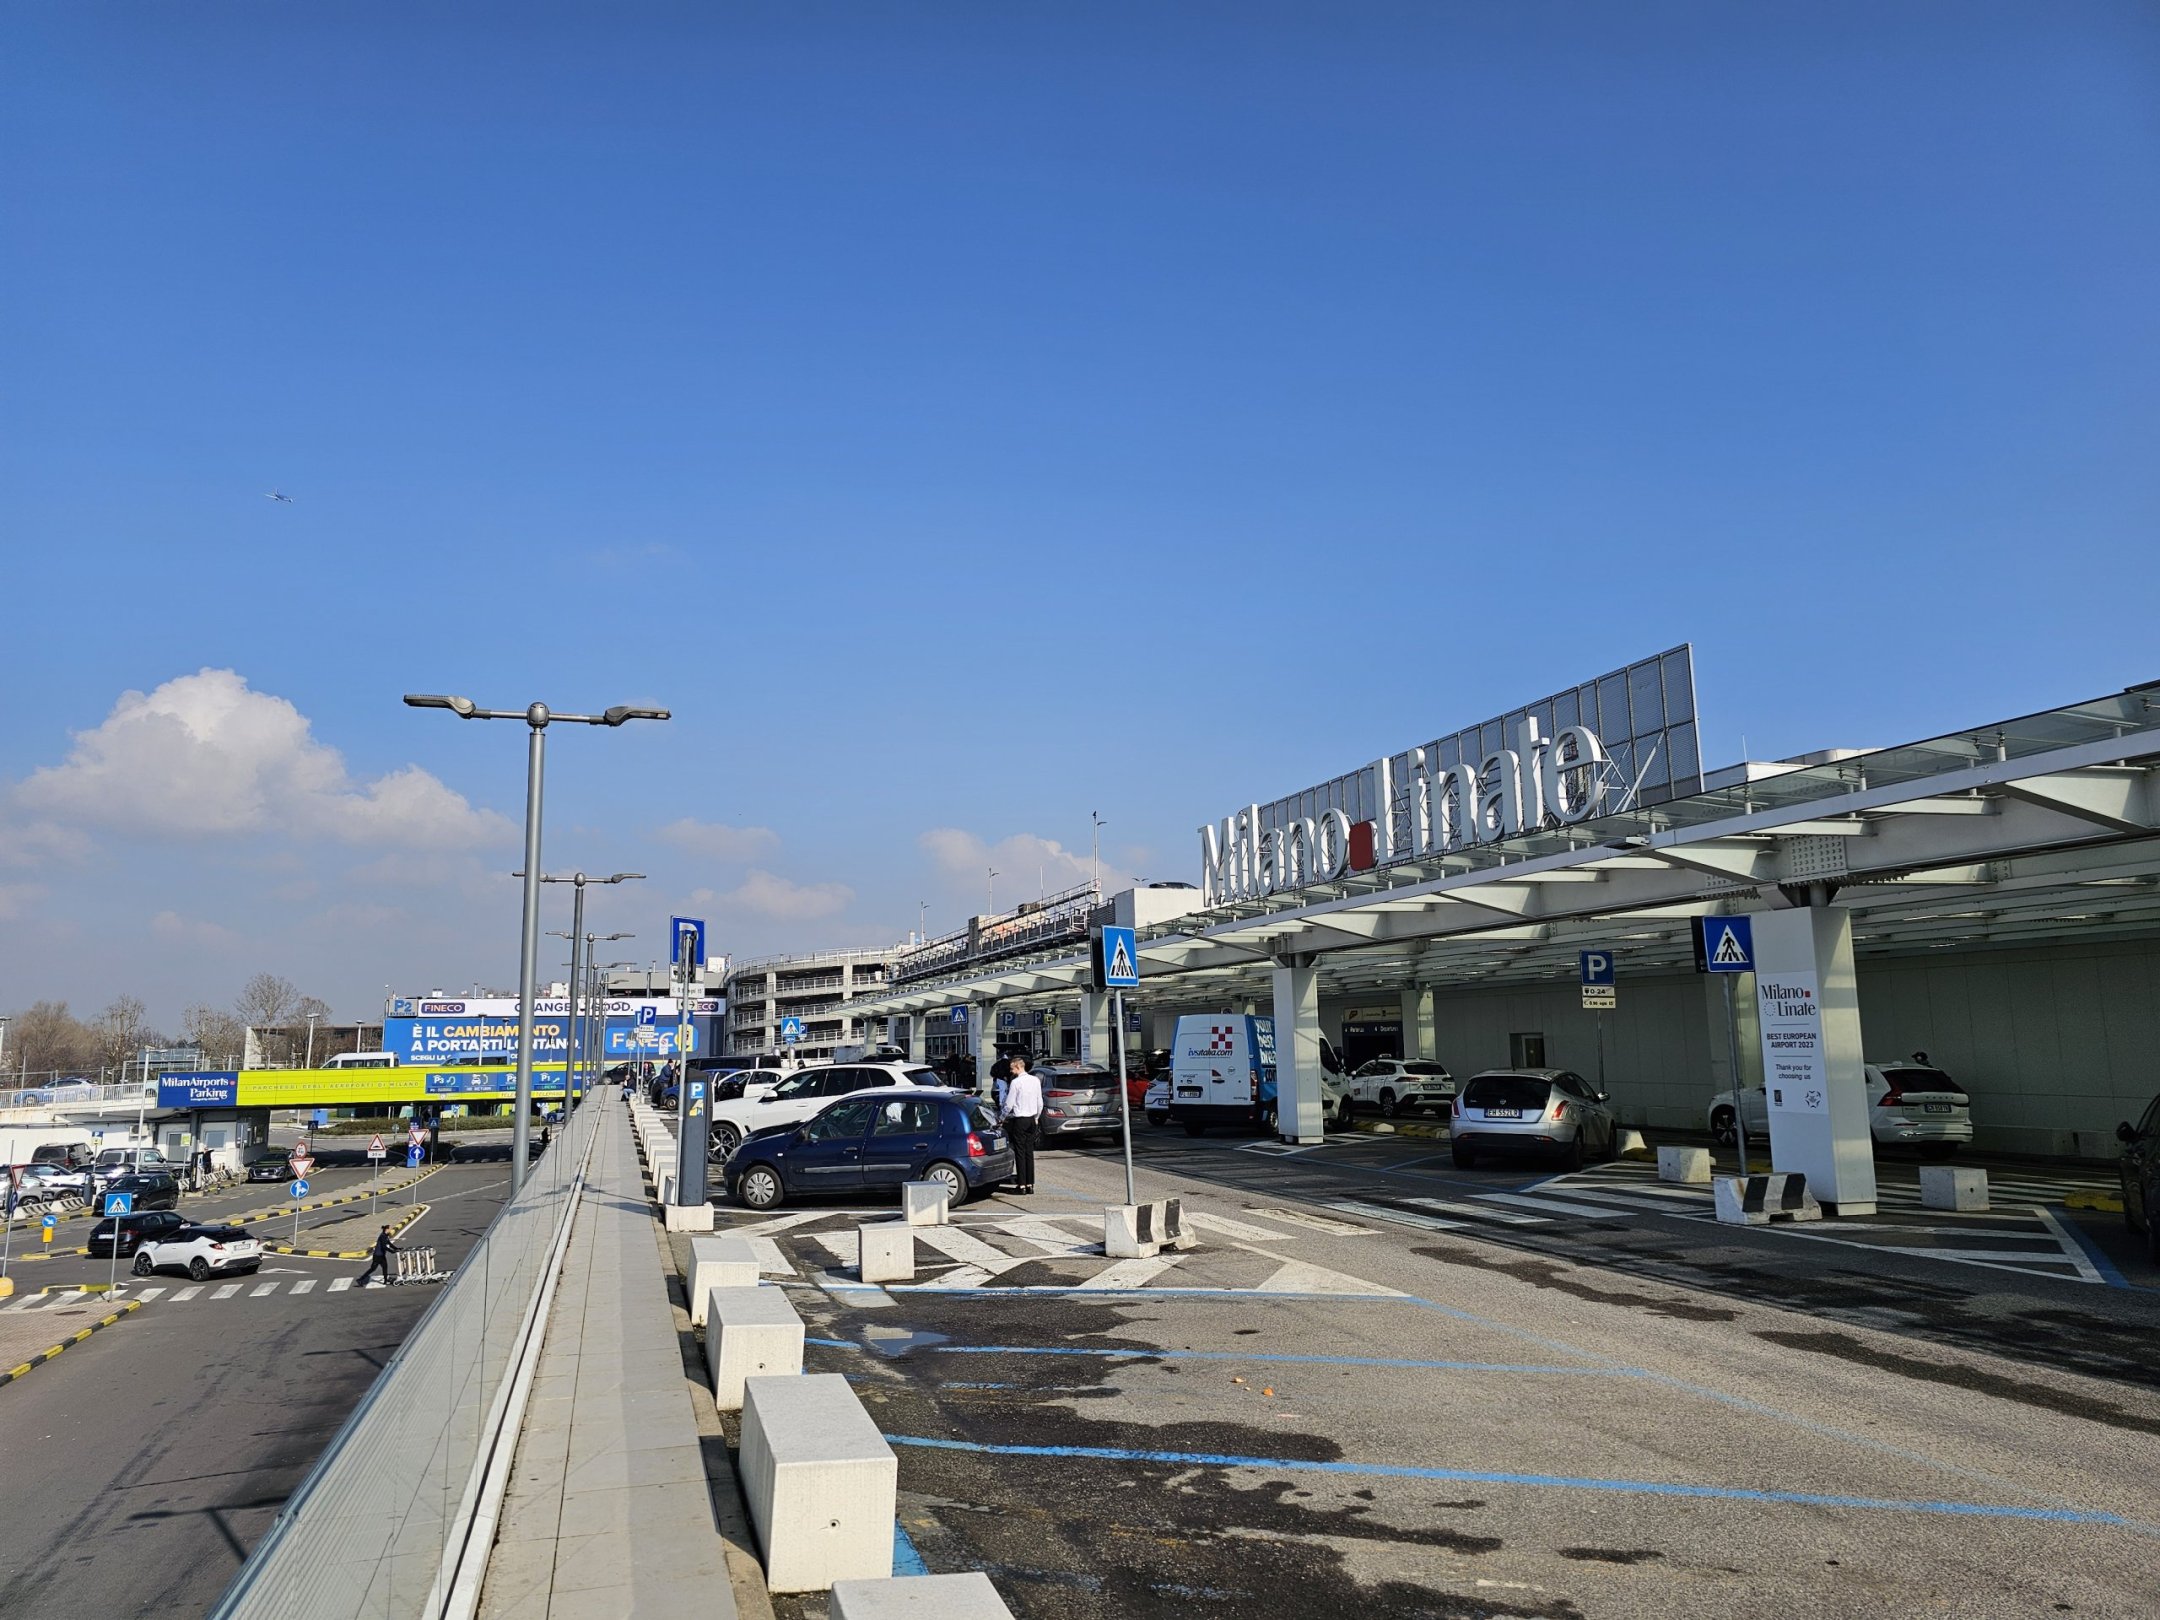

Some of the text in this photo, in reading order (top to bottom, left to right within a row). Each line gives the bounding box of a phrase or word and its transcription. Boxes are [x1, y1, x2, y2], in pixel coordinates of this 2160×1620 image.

[1197, 716, 1605, 907] Milano Linate
[1588, 955, 1607, 980] P
[1761, 984, 1804, 1000] Milano
[395, 1000, 412, 1012] P2
[424, 1004, 463, 1012] FINECO
[1778, 1001, 1816, 1016] Linate
[643, 1008, 654, 1024] P
[1005, 1013, 1013, 1025] P
[1034, 1012, 1041, 1024] P
[412, 1024, 560, 1037] È IL CAMBIAMNTO
[1783, 1032, 1816, 1040] EUROPEAN
[411, 1040, 423, 1051] A
[428, 1039, 503, 1051] PORTARTI
[1257, 1033, 1274, 1048] best
[1188, 1048, 1233, 1057] ivsitalia.com
[1792, 1064, 1802, 1072] you
[162, 1077, 229, 1088] MilanAirports
[433, 1076, 444, 1084] P3
[190, 1088, 228, 1099] Parking
[691, 1083, 703, 1096] P
